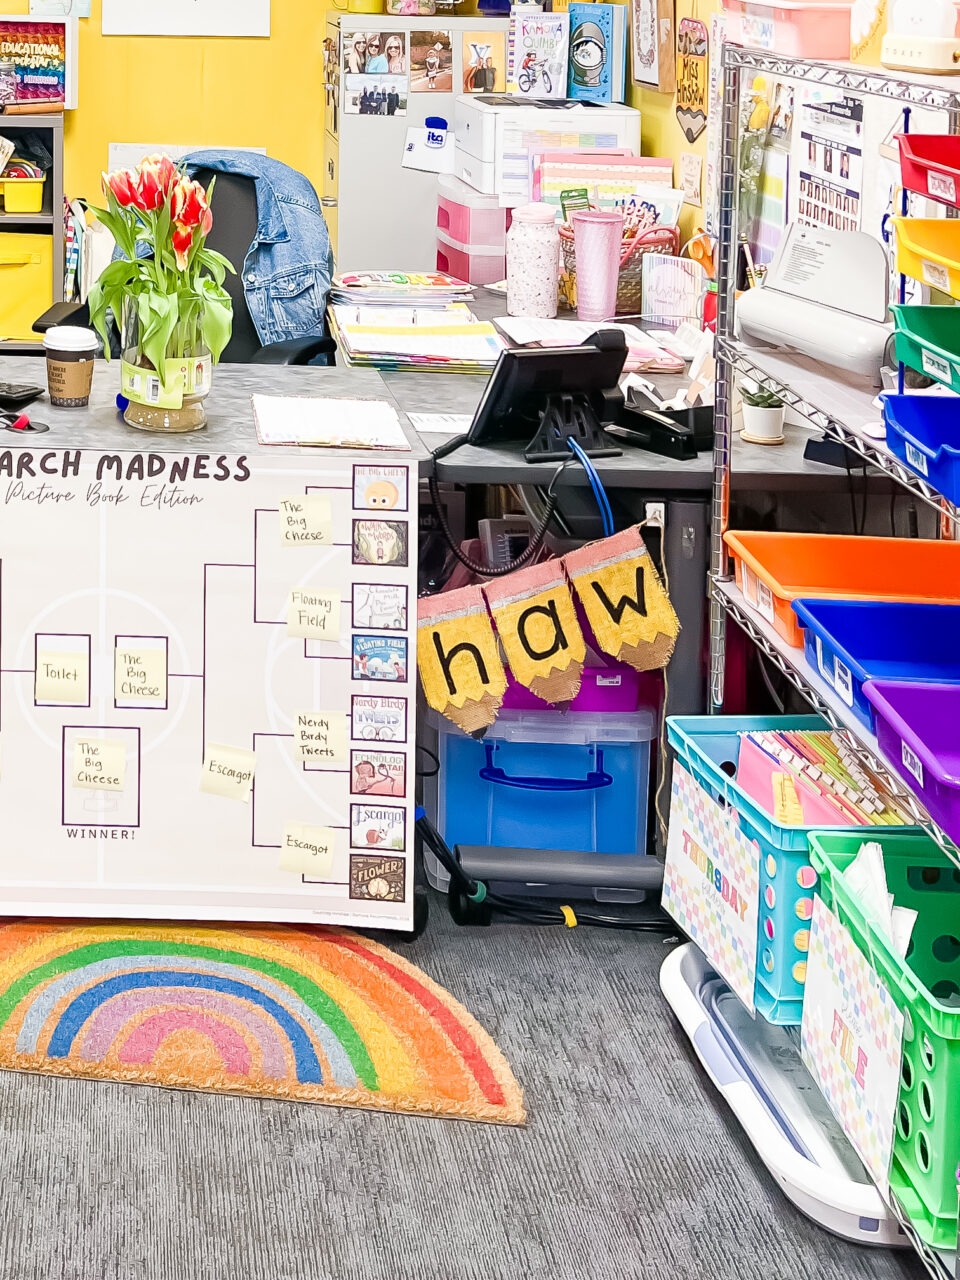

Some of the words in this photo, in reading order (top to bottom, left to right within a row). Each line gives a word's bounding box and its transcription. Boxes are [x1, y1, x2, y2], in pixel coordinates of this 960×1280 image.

[96, 454, 251, 483] MADNESS
[5, 480, 76, 505] Picture
[86, 481, 130, 507] Book
[140, 484, 204, 510] Edition
[281, 501, 303, 513] The
[286, 516, 307, 529] Big
[292, 591, 332, 613] Floating
[297, 610, 327, 630] Field
[119, 653, 142, 665] The
[43, 663, 79, 681] Toilet
[126, 668, 147, 684] Big
[298, 715, 329, 731] Nerdy
[300, 730, 327, 744] Birdy
[77, 742, 100, 756] The
[299, 745, 334, 758] Tweets
[84, 758, 103, 772] Big
[208, 760, 252, 785] Escargot
[66, 828, 136, 840] WINNER!
[286, 834, 329, 857] Escargot
[682, 829, 749, 922] THURSDAY
[830, 1008, 869, 1090] FILE
